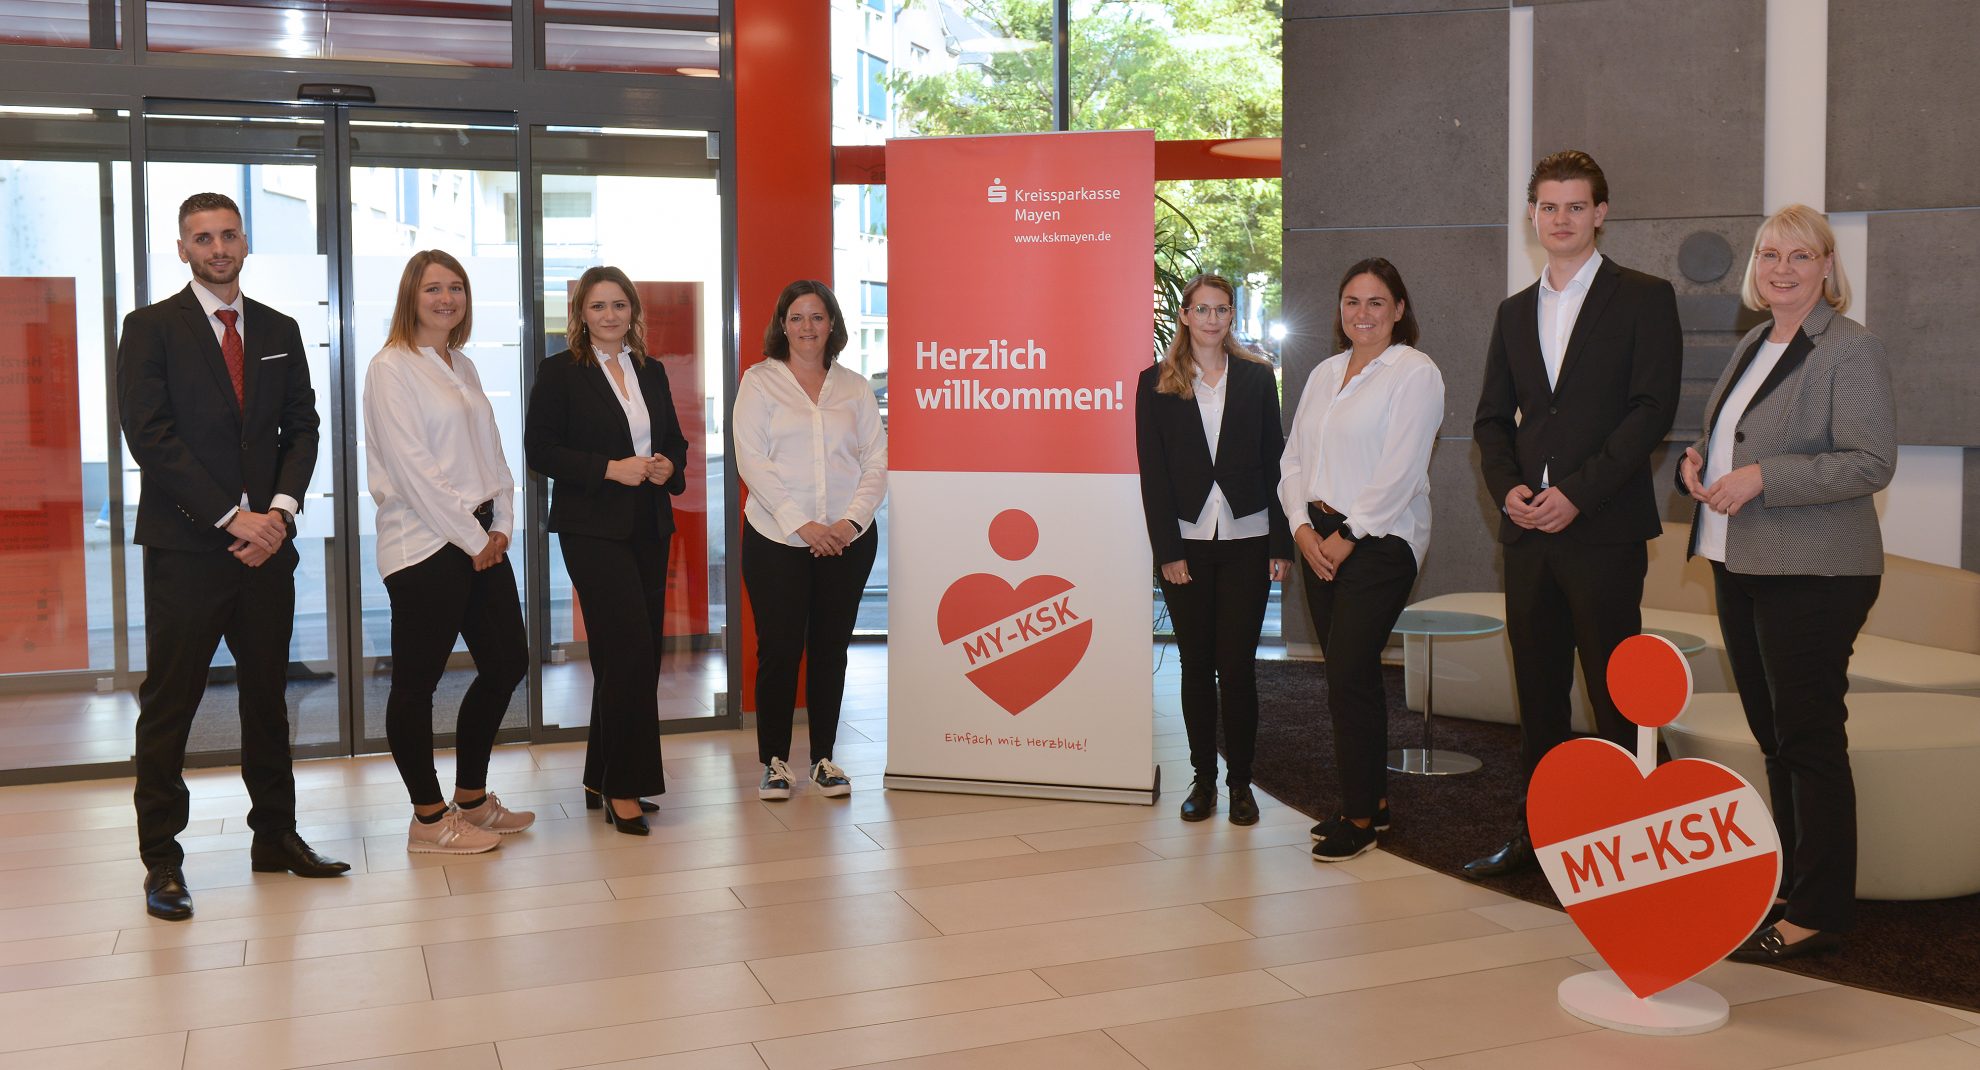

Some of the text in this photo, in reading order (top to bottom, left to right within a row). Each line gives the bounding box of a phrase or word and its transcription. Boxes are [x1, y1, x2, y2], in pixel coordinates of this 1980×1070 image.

[1015, 187, 1121, 204] Kreissparkasse
[1015, 208, 1061, 225] Mayen
[1014, 231, 1111, 245] www.kskmayen.de
[916, 339, 1047, 370] Herzlich
[915, 379, 1124, 410] willkommen!
[962, 596, 1080, 666] MY-KSK
[945, 732, 1088, 752] Einfach mit Herzblut!
[1560, 800, 1757, 895] MY-KSK
